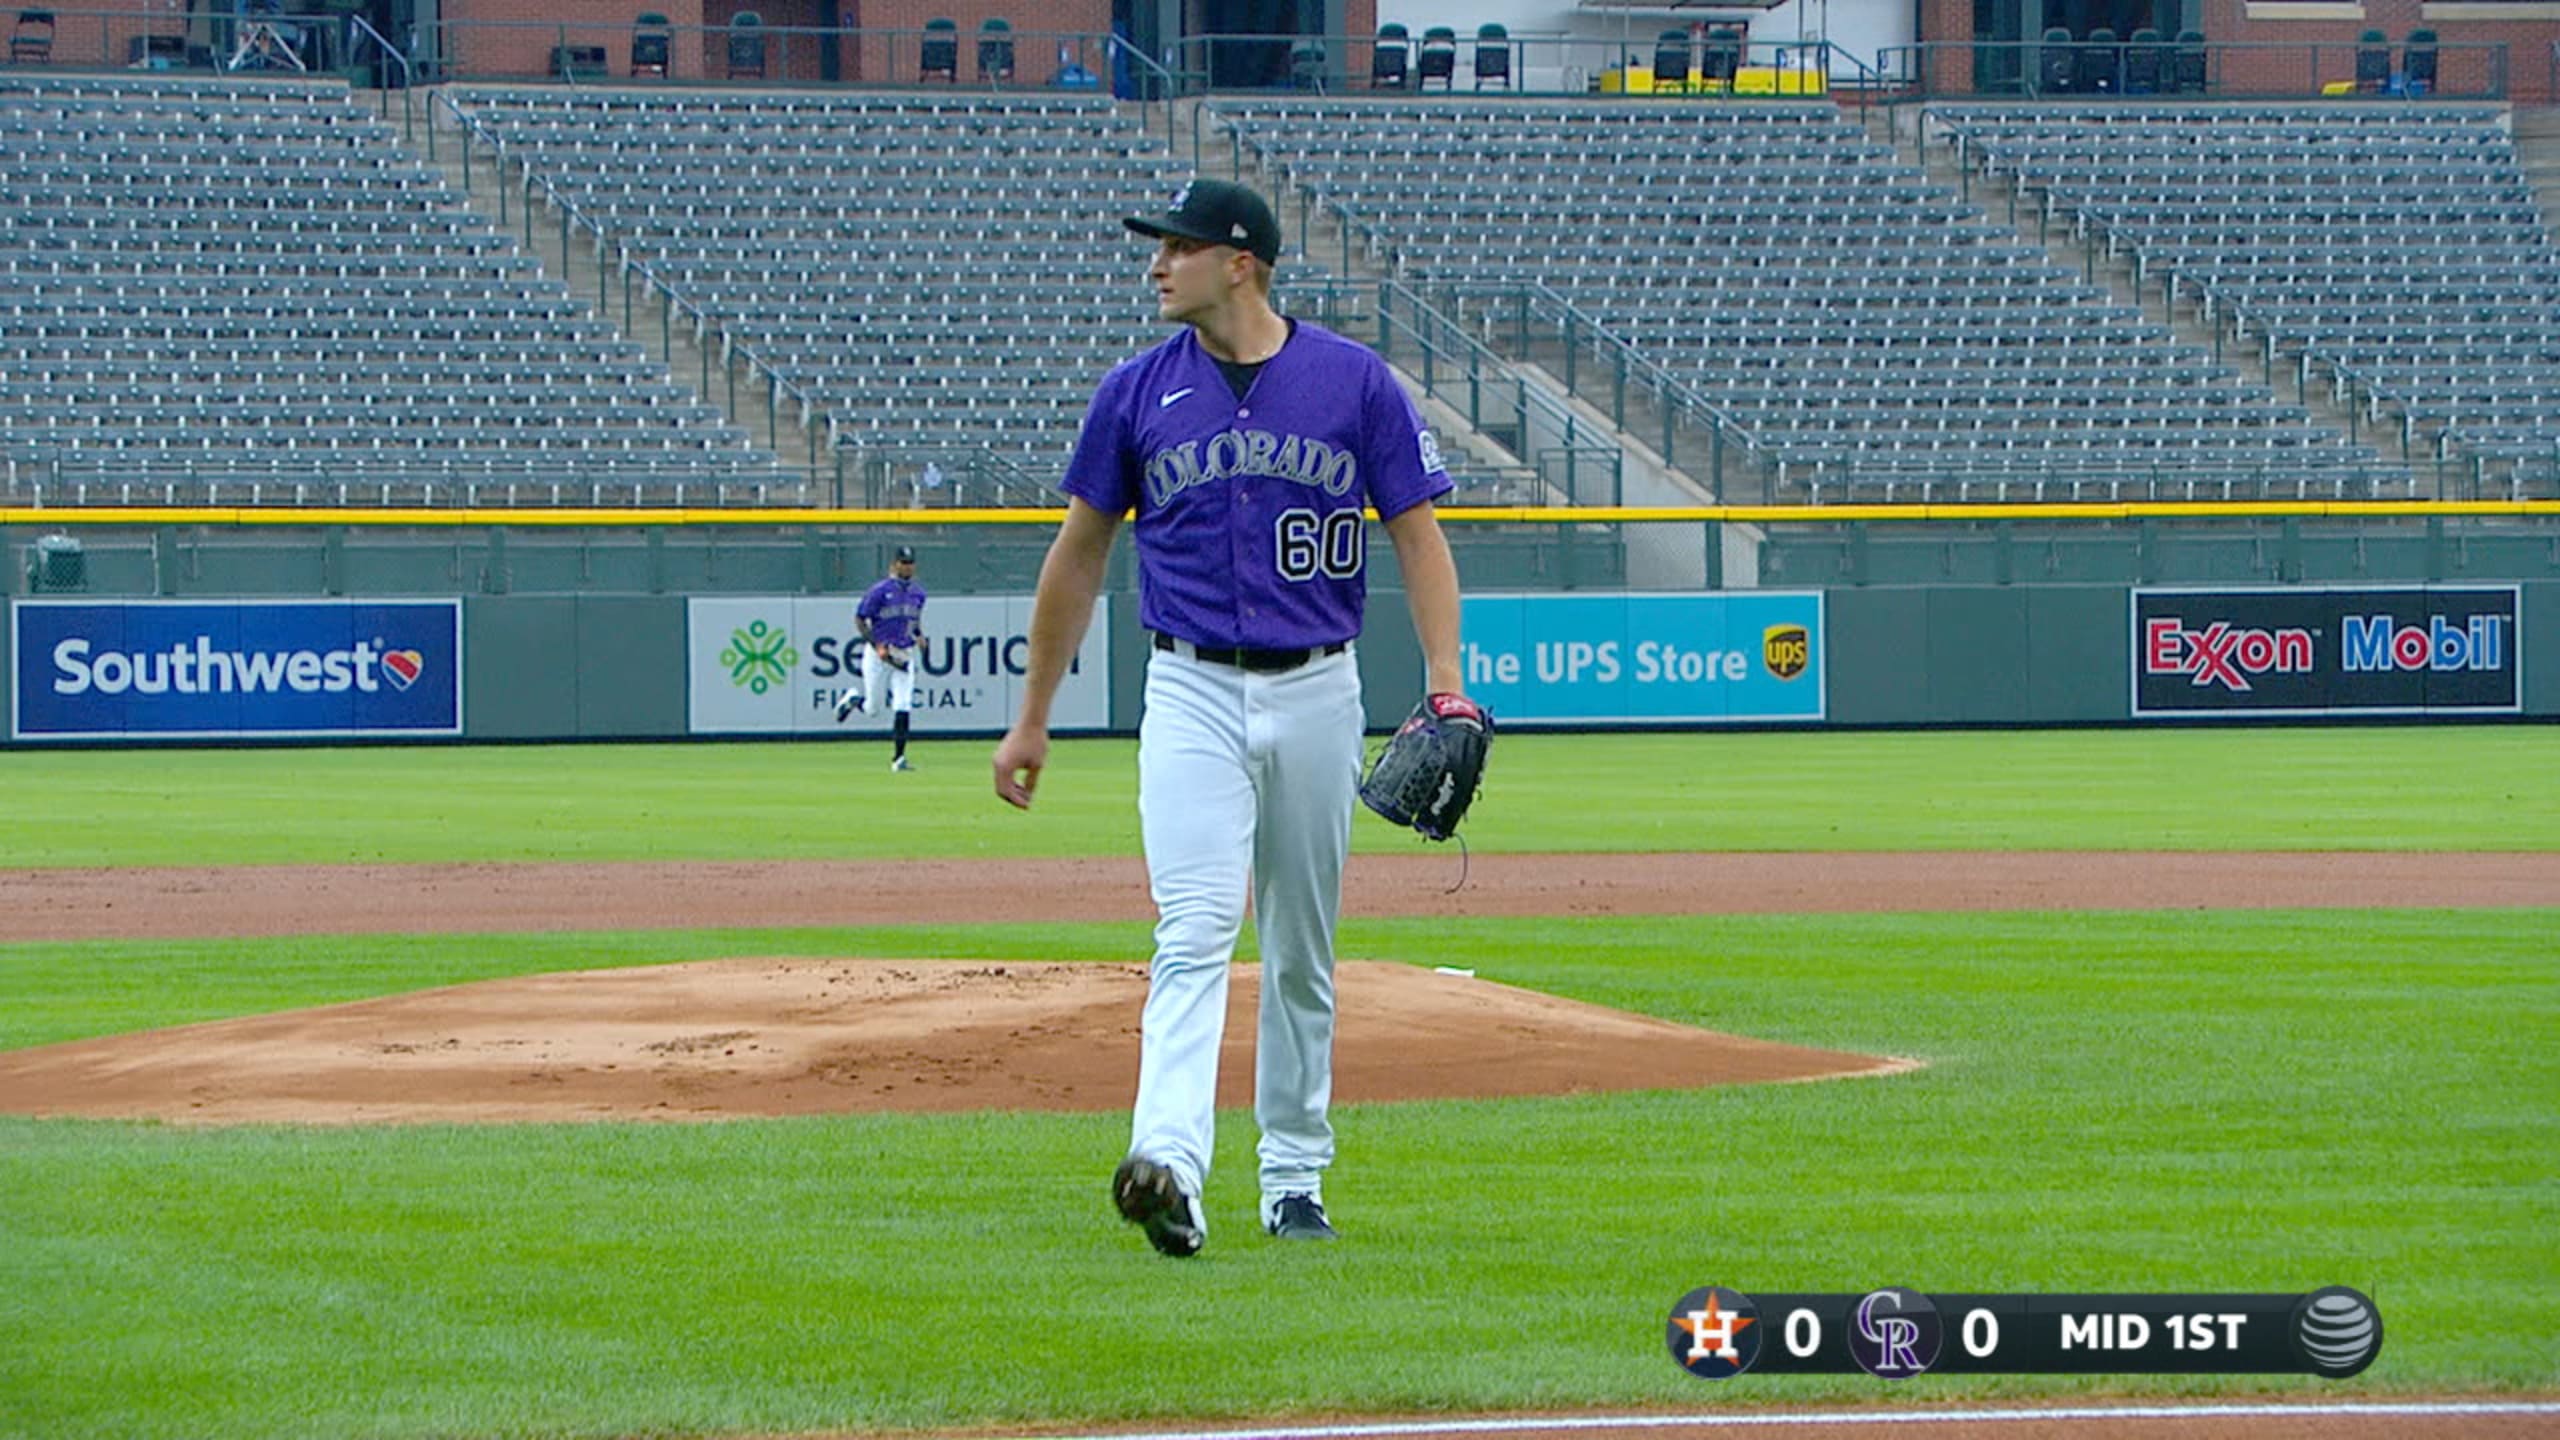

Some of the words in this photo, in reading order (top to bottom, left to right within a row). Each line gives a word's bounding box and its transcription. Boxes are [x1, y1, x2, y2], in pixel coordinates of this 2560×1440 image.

[1145, 428, 1356, 507] COLORADO
[1276, 508, 1363, 582] 60
[53, 635, 379, 694] Southwest
[1460, 642, 1520, 684] he
[1536, 642, 1621, 684] UPS
[1635, 641, 1748, 682] Store
[1765, 643, 1805, 675] ups
[2146, 618, 2313, 691] Exxon
[2342, 615, 2501, 671] Mobil
